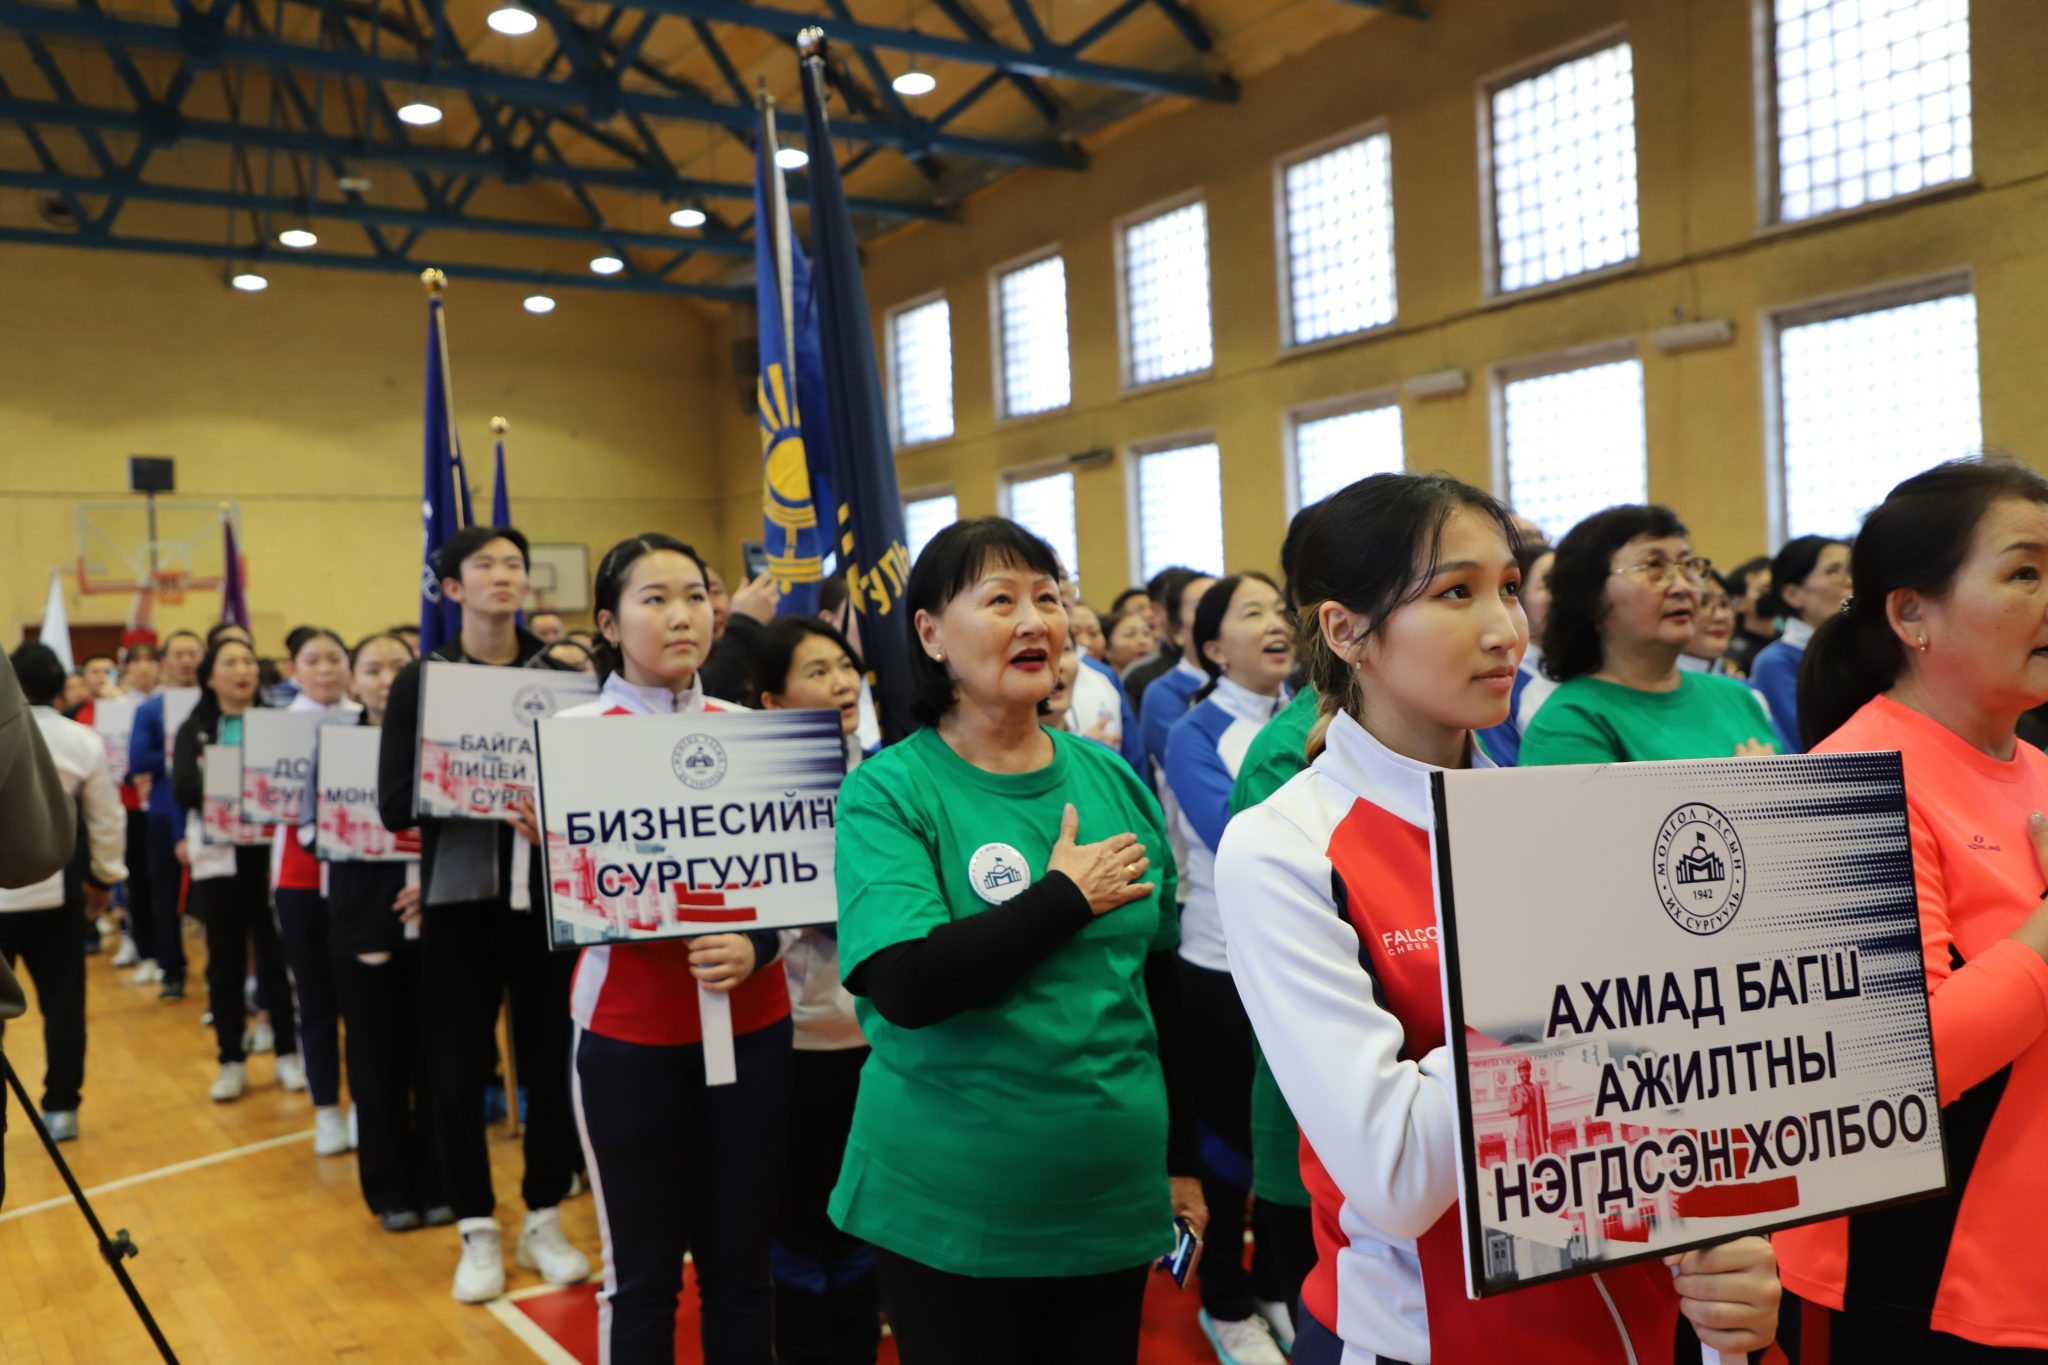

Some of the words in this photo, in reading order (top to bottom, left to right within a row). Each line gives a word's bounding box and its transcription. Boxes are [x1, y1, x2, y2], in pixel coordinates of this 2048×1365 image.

[566, 789, 835, 846] БИЗНЕСИЙН
[1656, 807, 1697, 876] МОНГОЛ
[597, 851, 819, 898] СУРГУУЛЬ
[1693, 888, 1713, 900] 1942
[1666, 897, 1682, 920] ИХ
[1686, 892, 1740, 931] СУРГУУЛЬ
[1387, 943, 1430, 956] CHEER
[1546, 966, 1726, 1038] АХМАД
[1736, 950, 1861, 1013] БАГШ
[1594, 1030, 1837, 1117] АЖИЛТНЫ
[1494, 1128, 1733, 1222] НЭГДСЭН
[1745, 1094, 1928, 1174] ХОЛБОО
